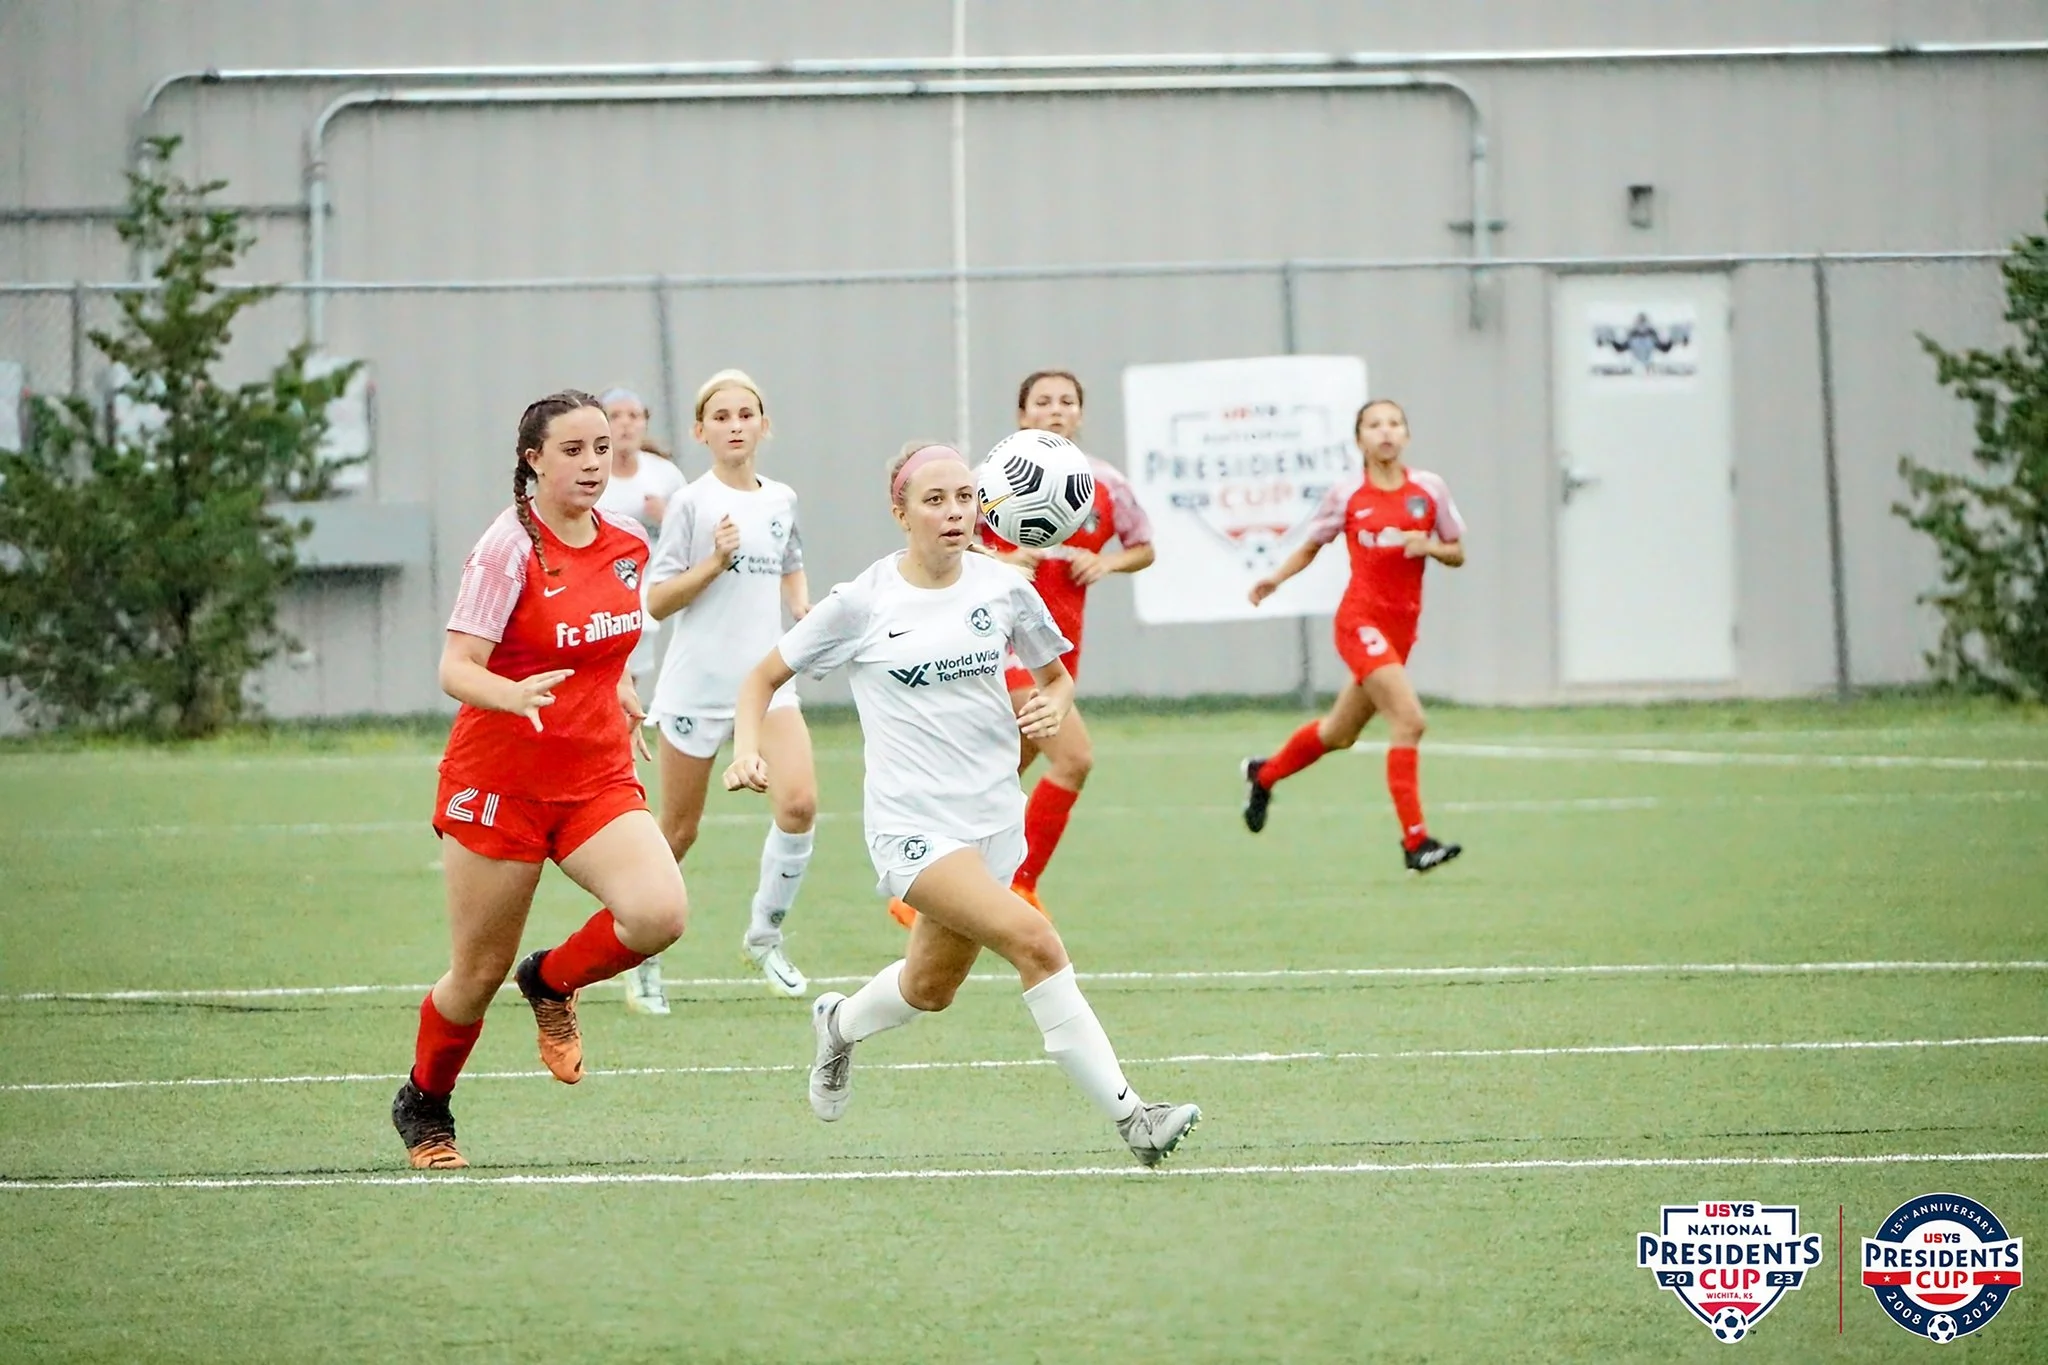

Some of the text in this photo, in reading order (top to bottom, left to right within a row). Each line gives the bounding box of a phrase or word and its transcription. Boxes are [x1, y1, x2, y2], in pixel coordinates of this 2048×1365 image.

[1219, 485, 1293, 508] CUP
[934, 655, 973, 671] World
[936, 664, 998, 682] Technolog
[445, 787, 500, 827] 21
